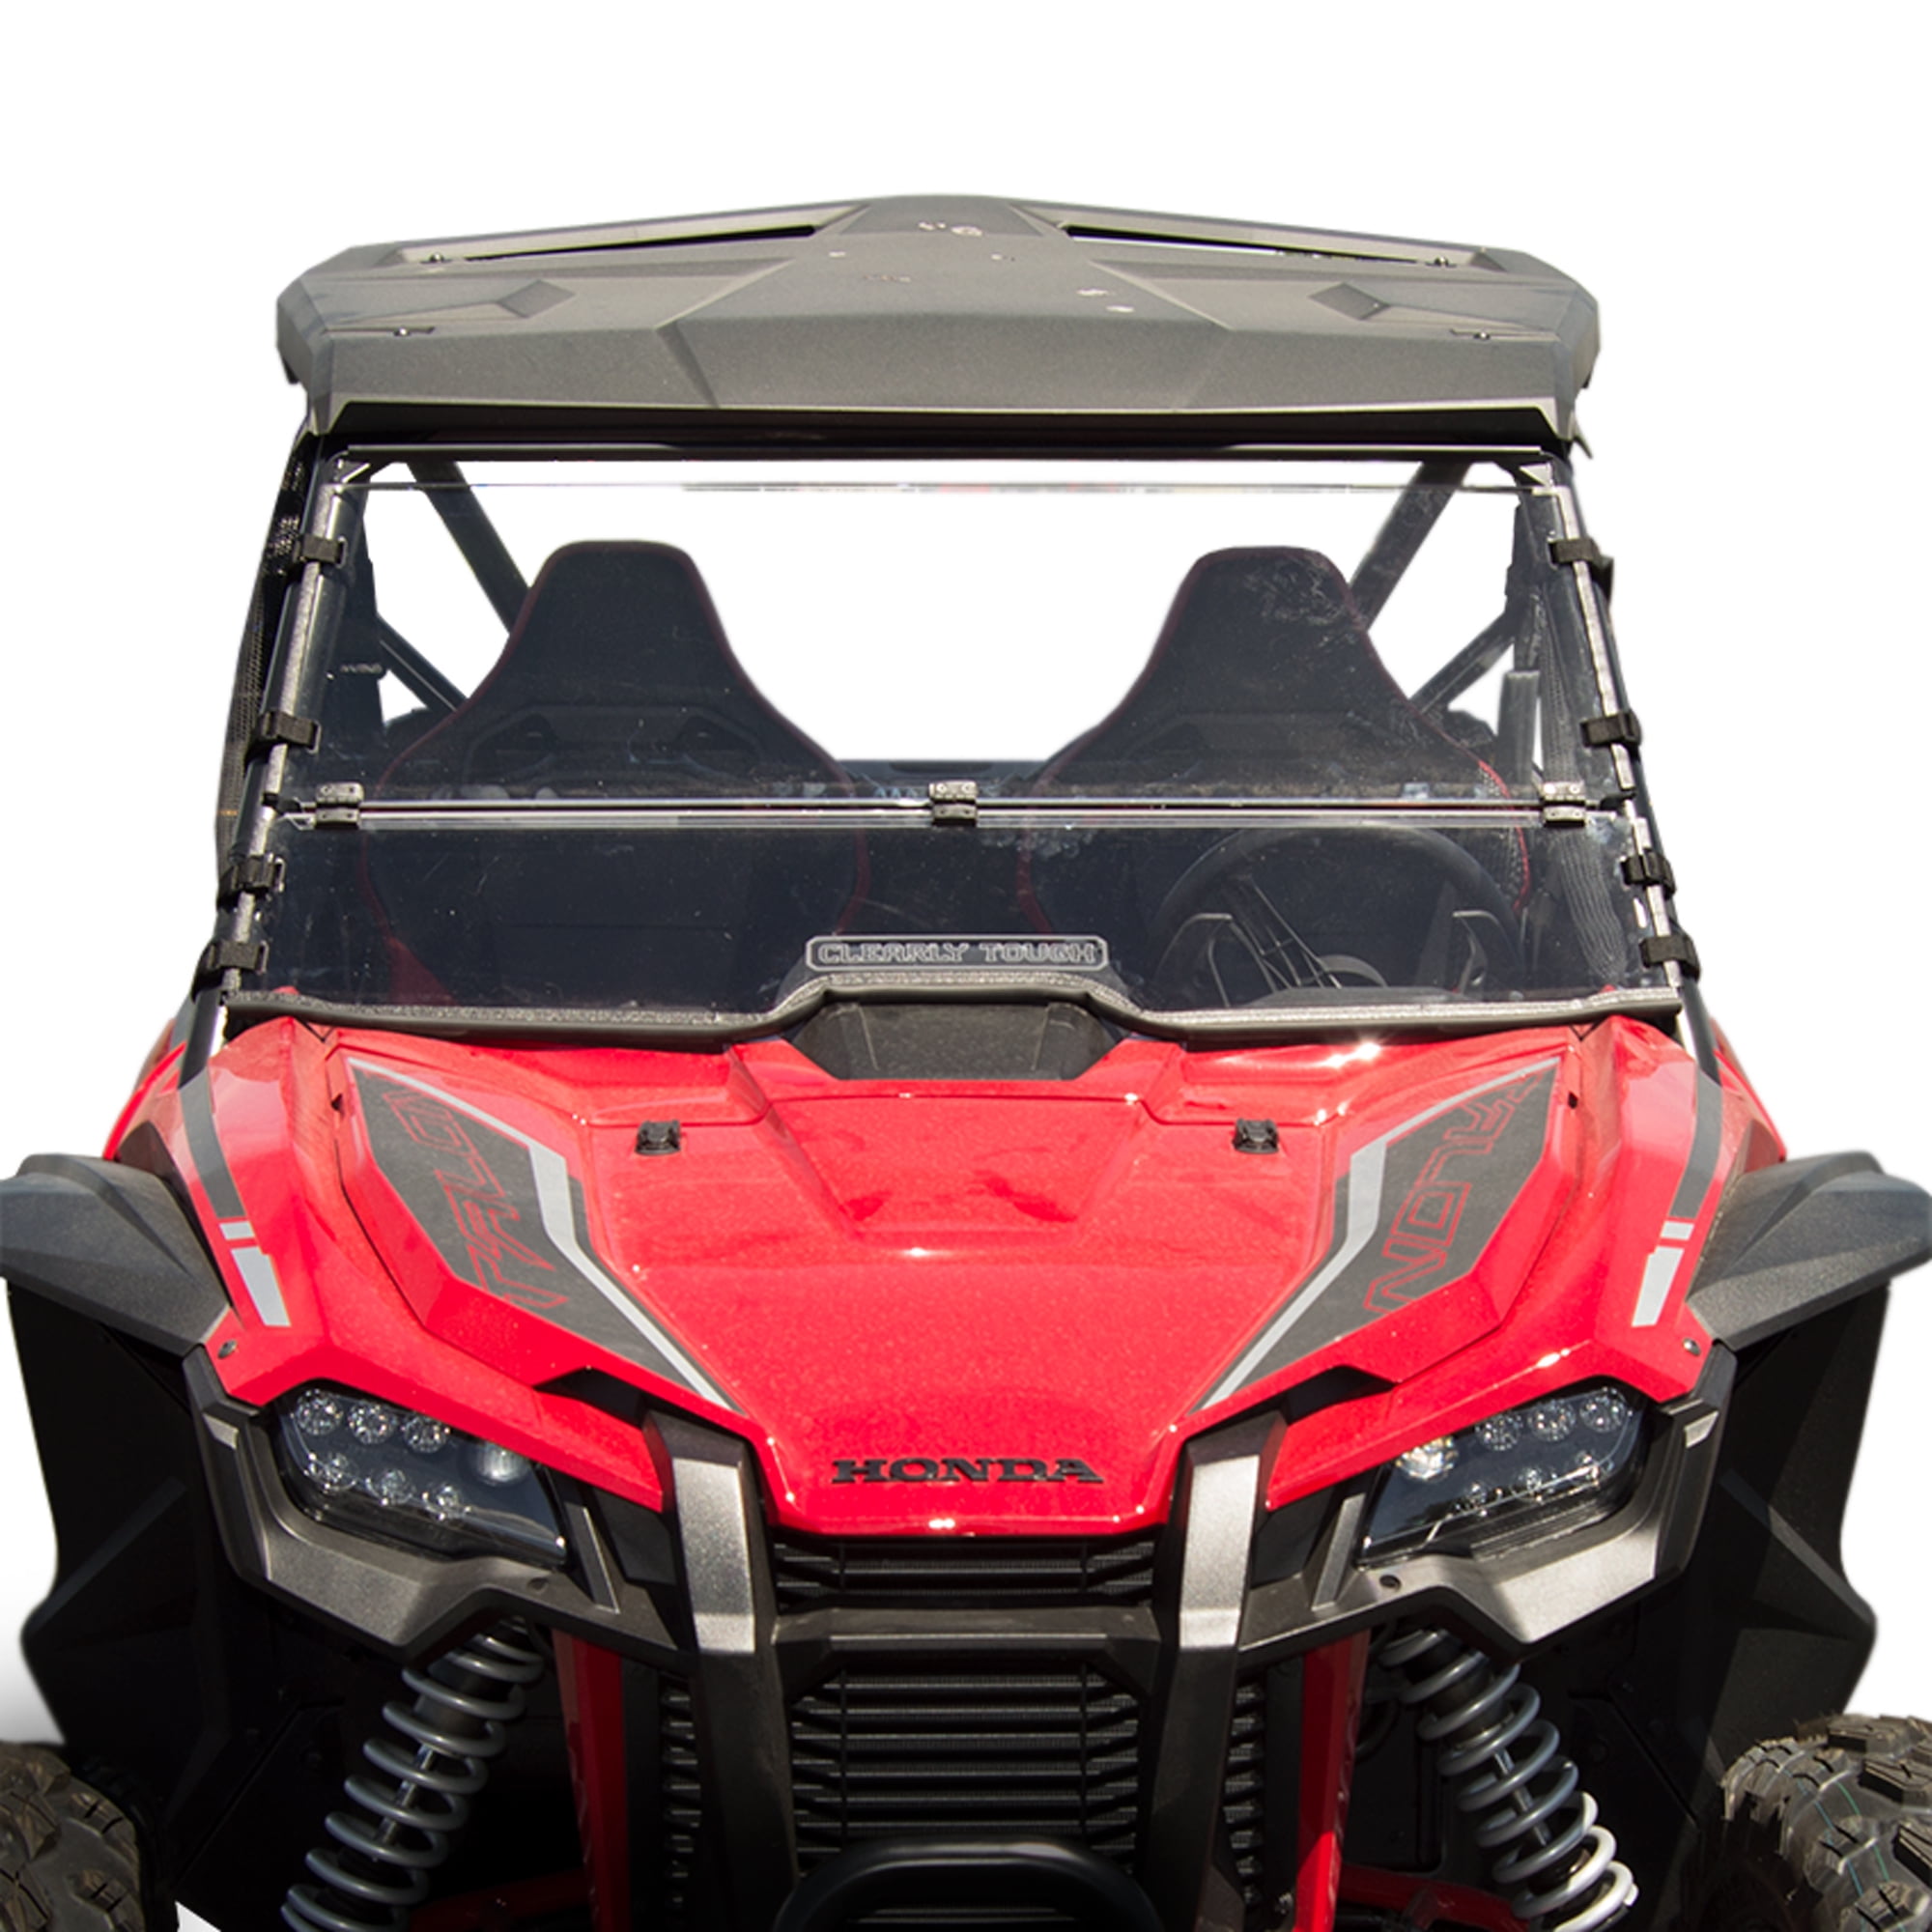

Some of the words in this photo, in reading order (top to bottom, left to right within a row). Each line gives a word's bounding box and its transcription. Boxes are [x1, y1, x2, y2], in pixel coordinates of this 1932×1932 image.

[817, 941, 970, 964] CLEARLY
[979, 941, 1098, 965] TOUGH
[831, 1458, 1105, 1486] HONDA
